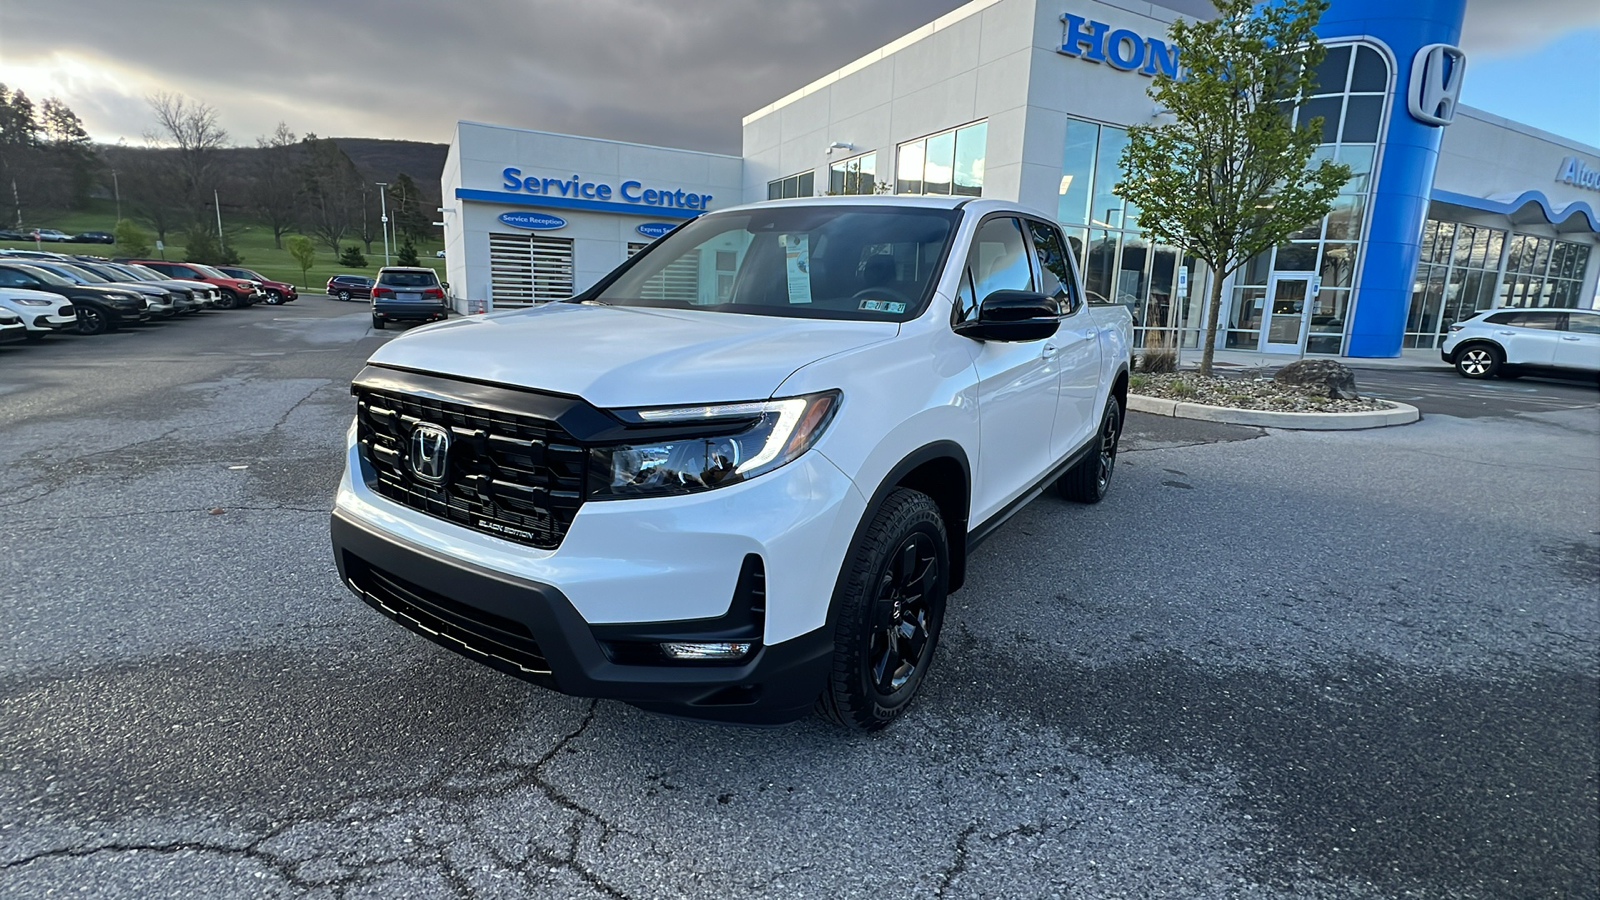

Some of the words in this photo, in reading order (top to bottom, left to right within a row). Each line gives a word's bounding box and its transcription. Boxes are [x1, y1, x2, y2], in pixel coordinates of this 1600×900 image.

[1057, 12, 1228, 86] HON
[503, 168, 613, 200] Service
[621, 181, 713, 209] Center
[503, 215, 528, 223] Service
[529, 217, 563, 225] Reception
[640, 226, 662, 234] Express
[478, 520, 503, 531] BLACK
[503, 527, 534, 539] EDITION
